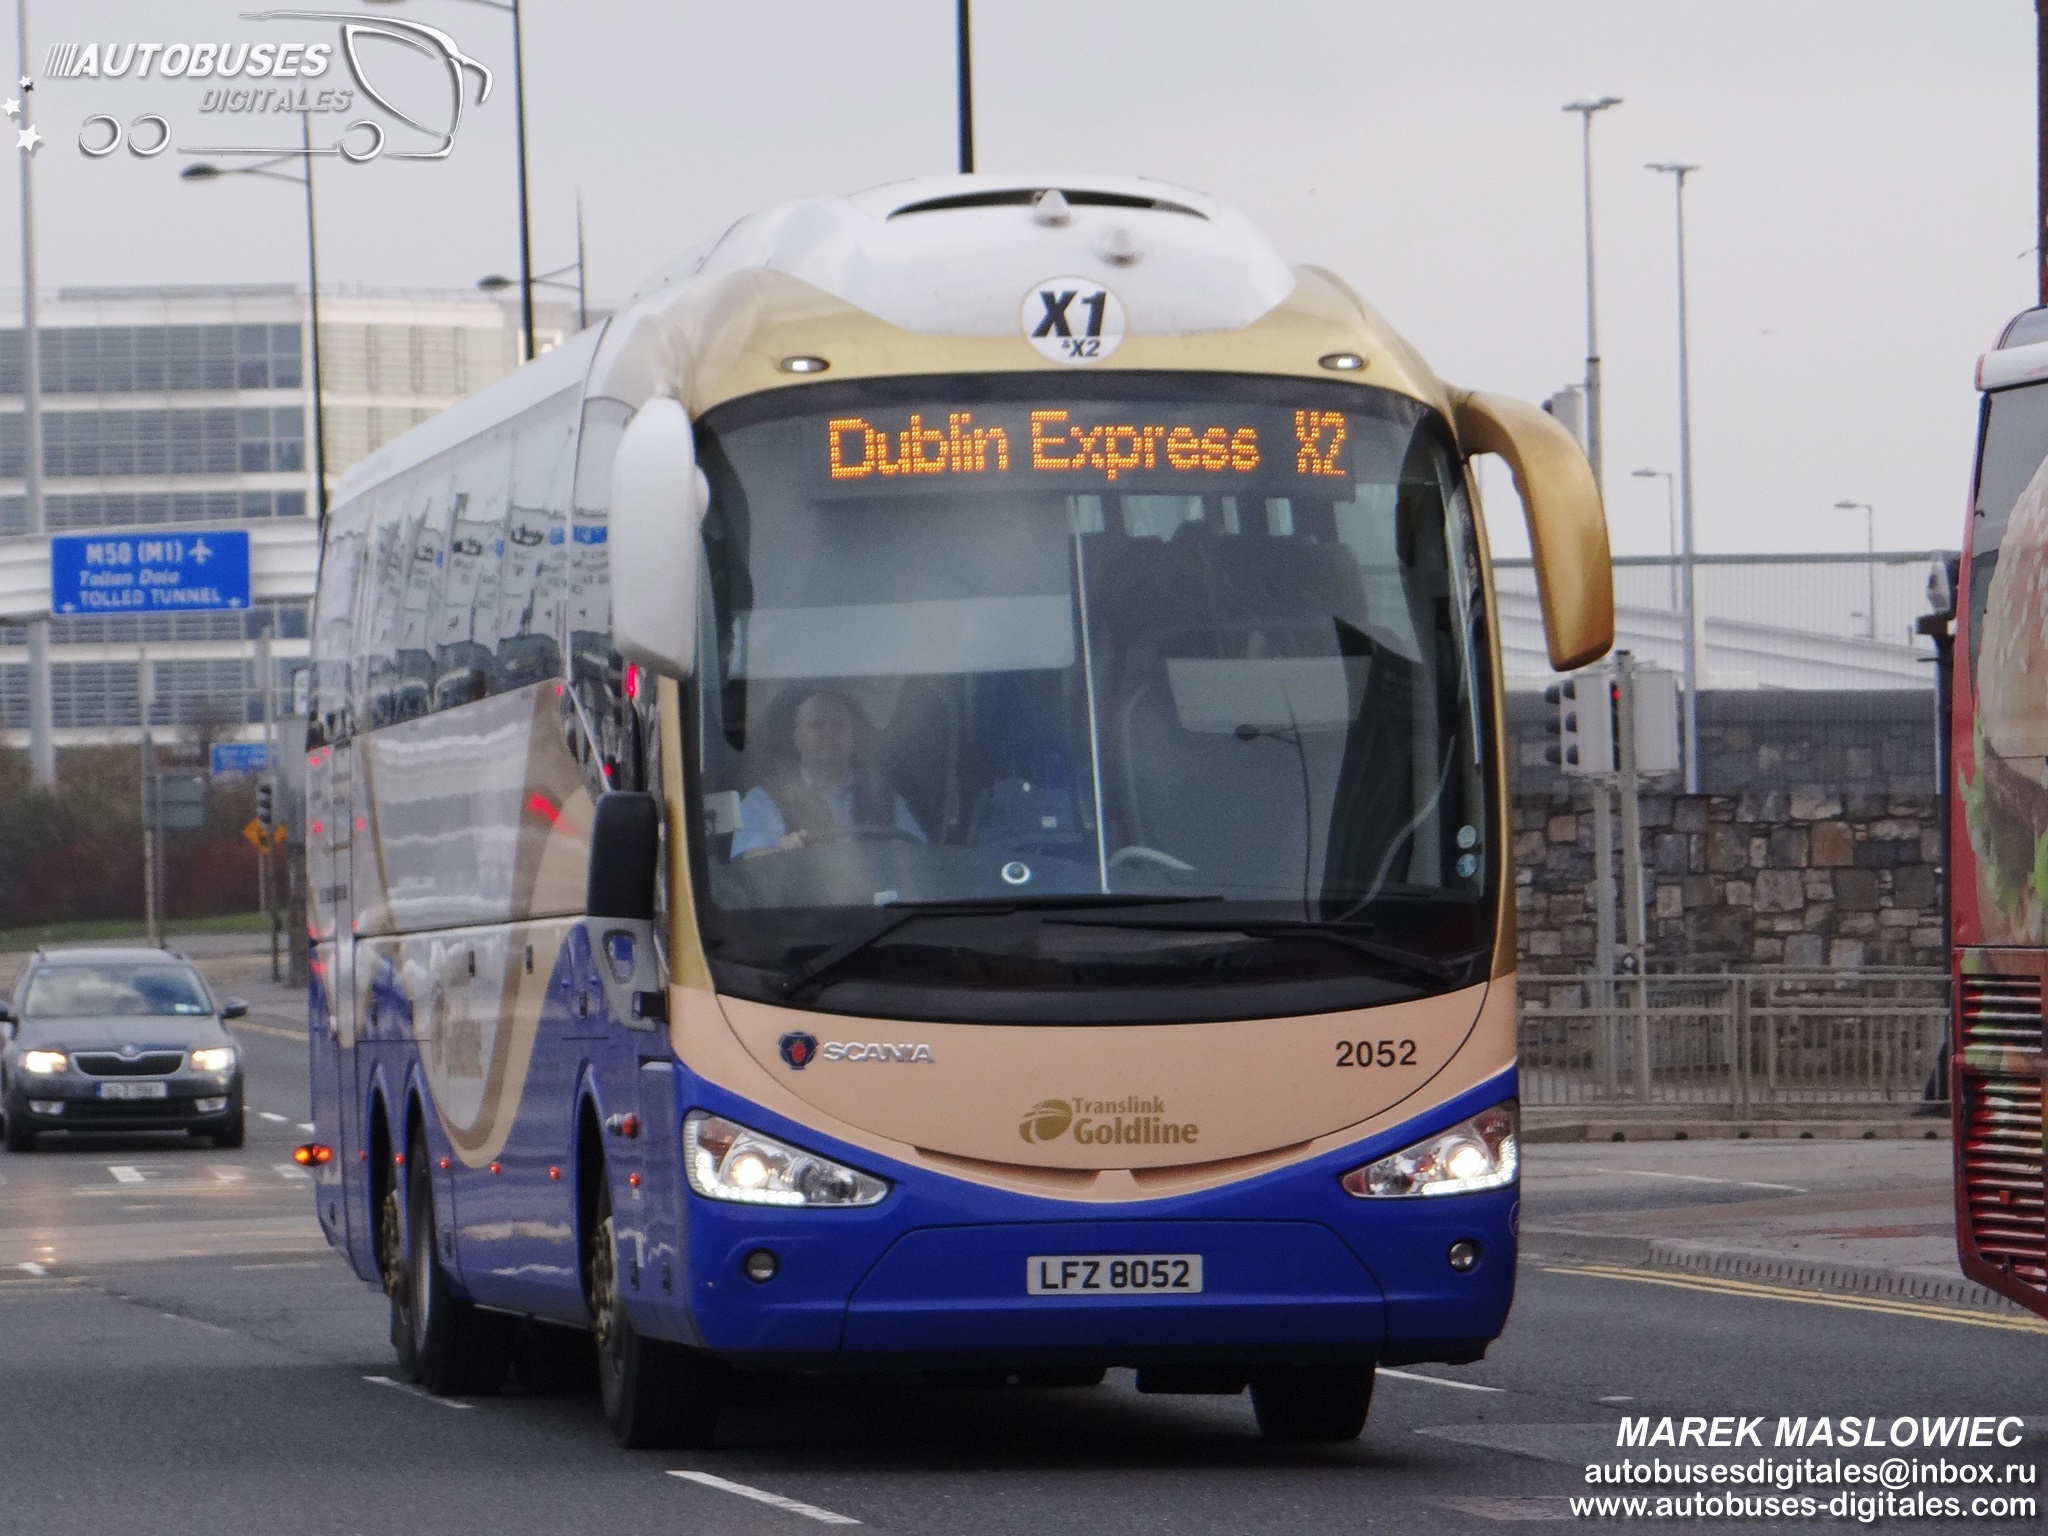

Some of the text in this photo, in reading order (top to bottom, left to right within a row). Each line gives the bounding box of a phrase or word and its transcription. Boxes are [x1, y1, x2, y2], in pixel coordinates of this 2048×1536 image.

[1031, 291, 1107, 338] X1
[828, 412, 1009, 479] Dublin
[1031, 410, 1260, 480] Express
[85, 541, 132, 565] M50
[79, 587, 222, 607] TOLLED TUNNEL
[822, 1041, 934, 1063] SCANIA
[1334, 1040, 1418, 1067] 2052
[1072, 1096, 1165, 1115] Translink
[1073, 1114, 1199, 1145] Goldline
[1039, 1259, 1190, 1290] LFZ 8052
